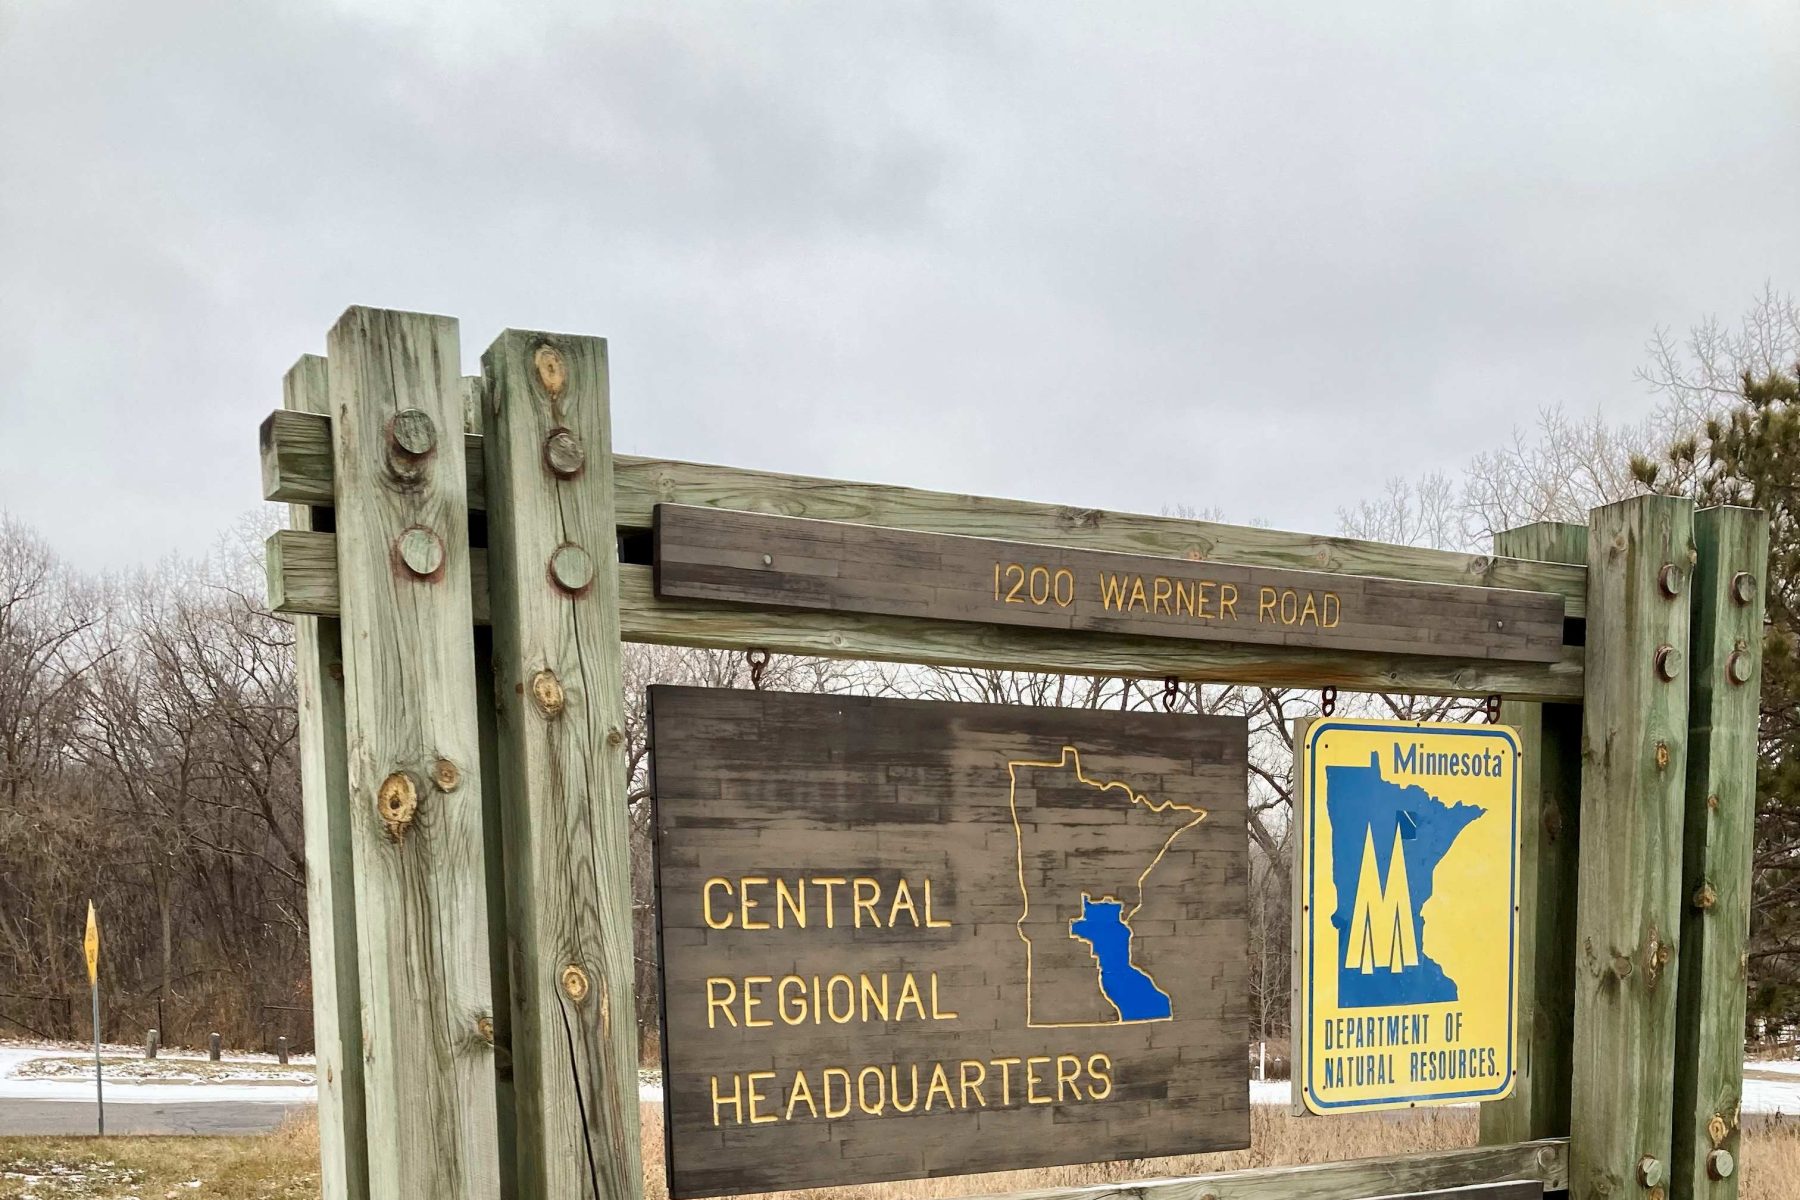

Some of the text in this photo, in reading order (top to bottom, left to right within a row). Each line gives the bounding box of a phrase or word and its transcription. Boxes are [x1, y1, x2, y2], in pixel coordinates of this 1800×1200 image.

[994, 561, 1341, 628] 1200 WARNER ROAD
[1394, 742, 1502, 777] Minnesota
[703, 877, 952, 930] CENTRAL
[706, 972, 958, 1028] REGIONAL
[1324, 1012, 1463, 1051] DEPARTMENT OF
[711, 1053, 1112, 1127] HEADQUARTERS
[1324, 1053, 1395, 1090] NATURAL
